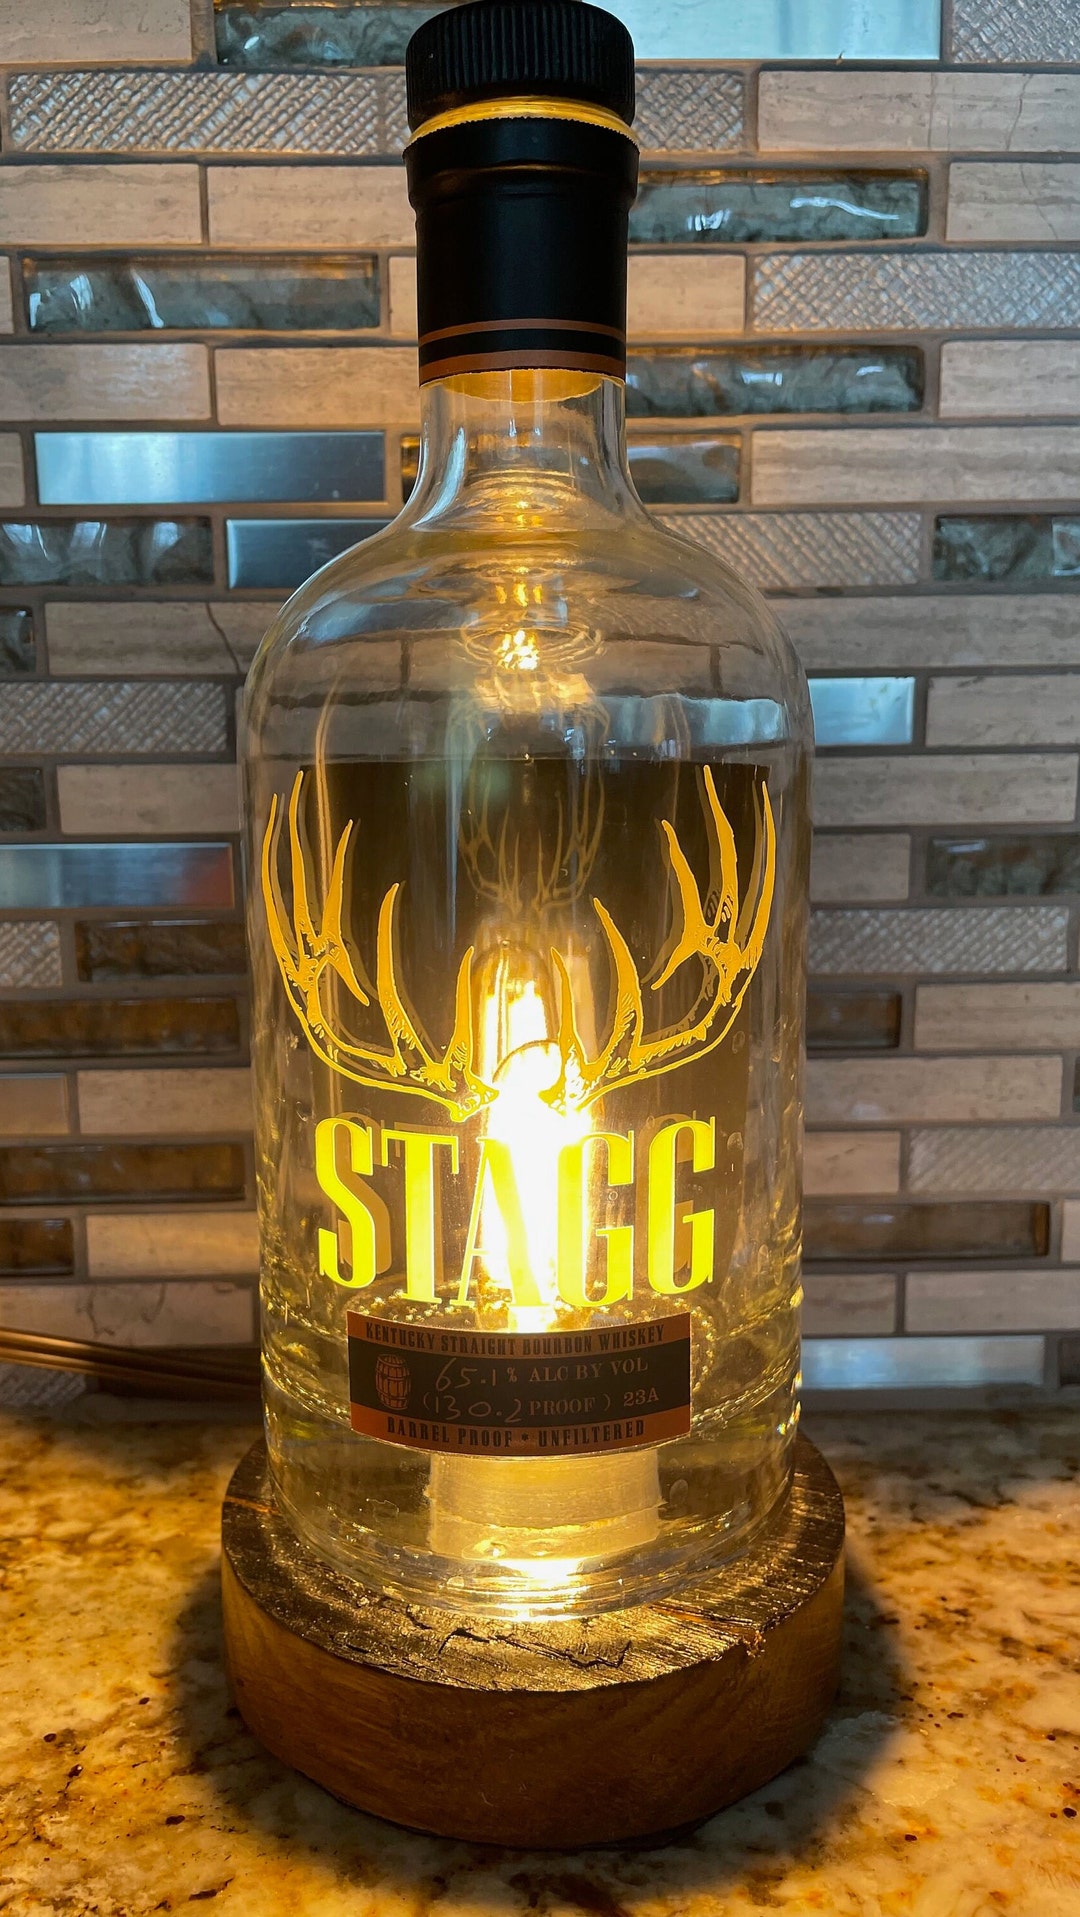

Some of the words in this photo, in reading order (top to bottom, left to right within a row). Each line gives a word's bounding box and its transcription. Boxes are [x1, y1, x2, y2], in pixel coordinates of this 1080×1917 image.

[315, 1116, 716, 1308] STAGG
[366, 1322, 435, 1349] KENTUCKY
[441, 1335, 516, 1356] STRAIGHT
[523, 1335, 592, 1356] BOURBON
[599, 1324, 665, 1350] WHISKEY
[529, 1365, 569, 1382] ALC
[576, 1363, 603, 1380] BY
[611, 1357, 649, 1376] VOL
[623, 1387, 660, 1407] 23A
[387, 1416, 450, 1443] BARREL
[458, 1427, 513, 1448] PROOF
[538, 1419, 645, 1448] UNFILTERED
